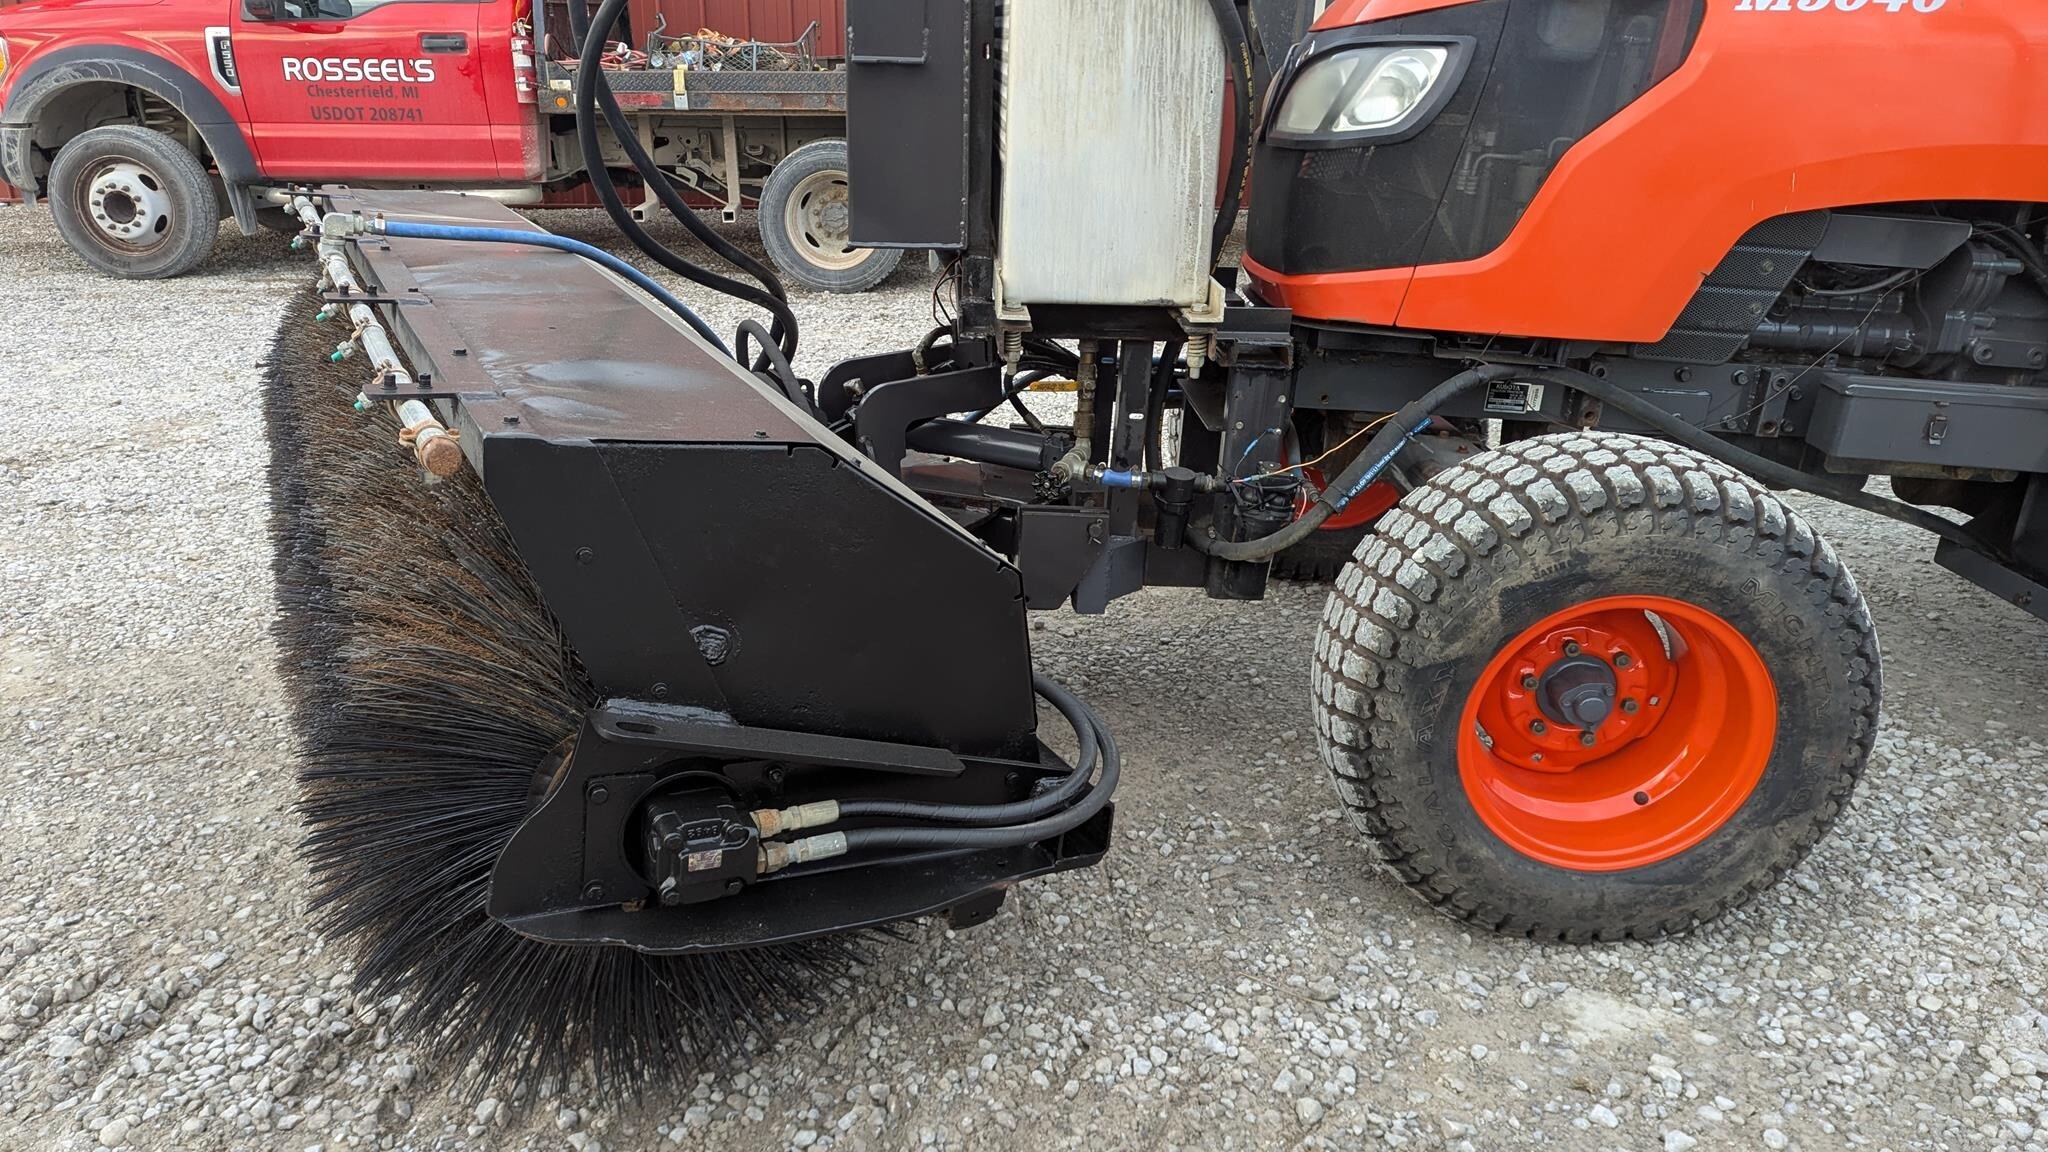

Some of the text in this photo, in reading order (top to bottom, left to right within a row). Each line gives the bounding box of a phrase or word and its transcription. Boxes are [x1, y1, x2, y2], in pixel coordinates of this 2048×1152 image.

[221, 39, 235, 78] F550
[282, 57, 436, 82] ROSSEEL'S
[306, 84, 420, 100] Chesterfield, MI
[310, 106, 424, 122] USDOT 208741
[1739, 576, 1833, 720] MIGHTY
